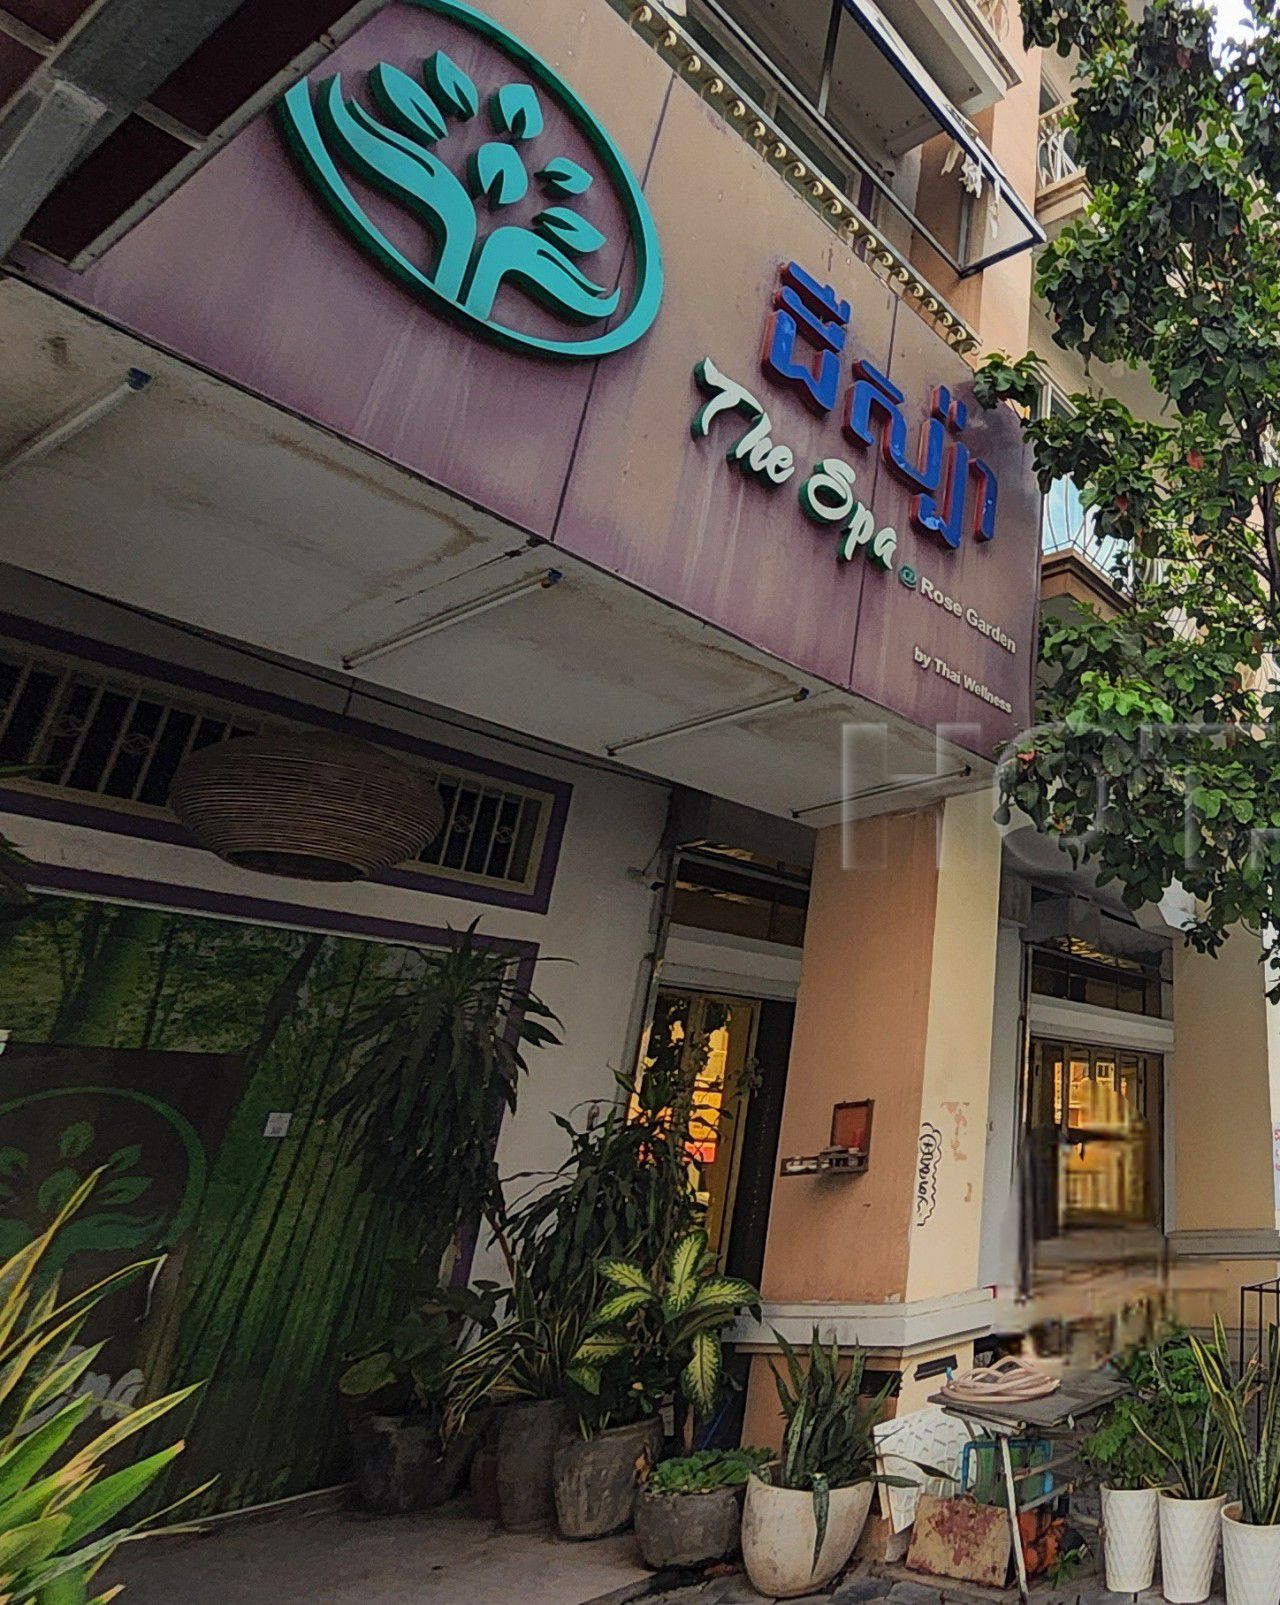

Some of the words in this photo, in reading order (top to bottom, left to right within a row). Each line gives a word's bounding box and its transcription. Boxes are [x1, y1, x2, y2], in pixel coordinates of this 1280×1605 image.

[697, 356, 795, 485] The
[802, 458, 898, 570] Spa
[920, 576, 963, 617] Rose
[966, 608, 1017, 654] Garden
[914, 646, 932, 669] by
[933, 657, 961, 686] Thai
[963, 674, 1013, 714] Wellness
